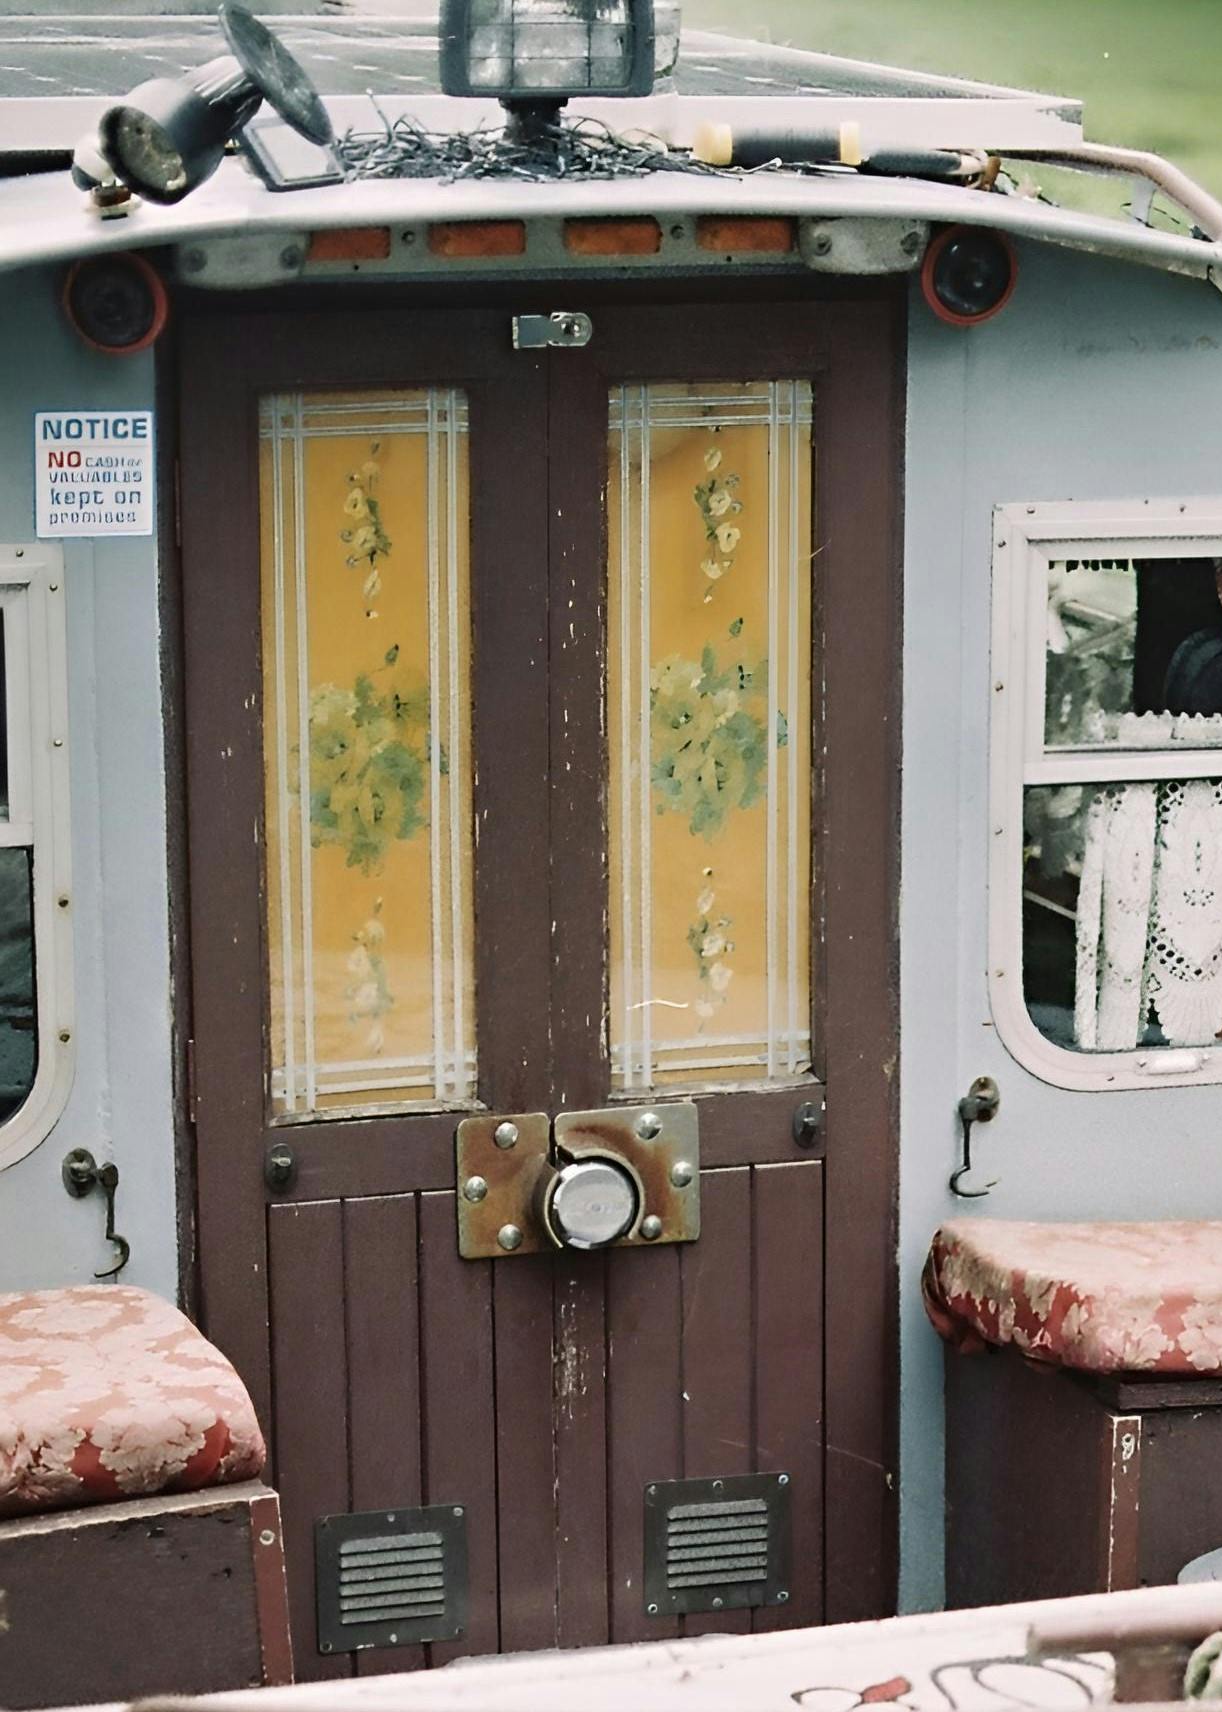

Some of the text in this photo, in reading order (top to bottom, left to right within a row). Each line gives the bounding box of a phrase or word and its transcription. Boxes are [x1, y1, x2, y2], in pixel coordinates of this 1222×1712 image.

[43, 418, 148, 440] NOTICE
[48, 451, 82, 468] NO
[50, 488, 141, 510] kept on
[49, 511, 136, 525] premises
